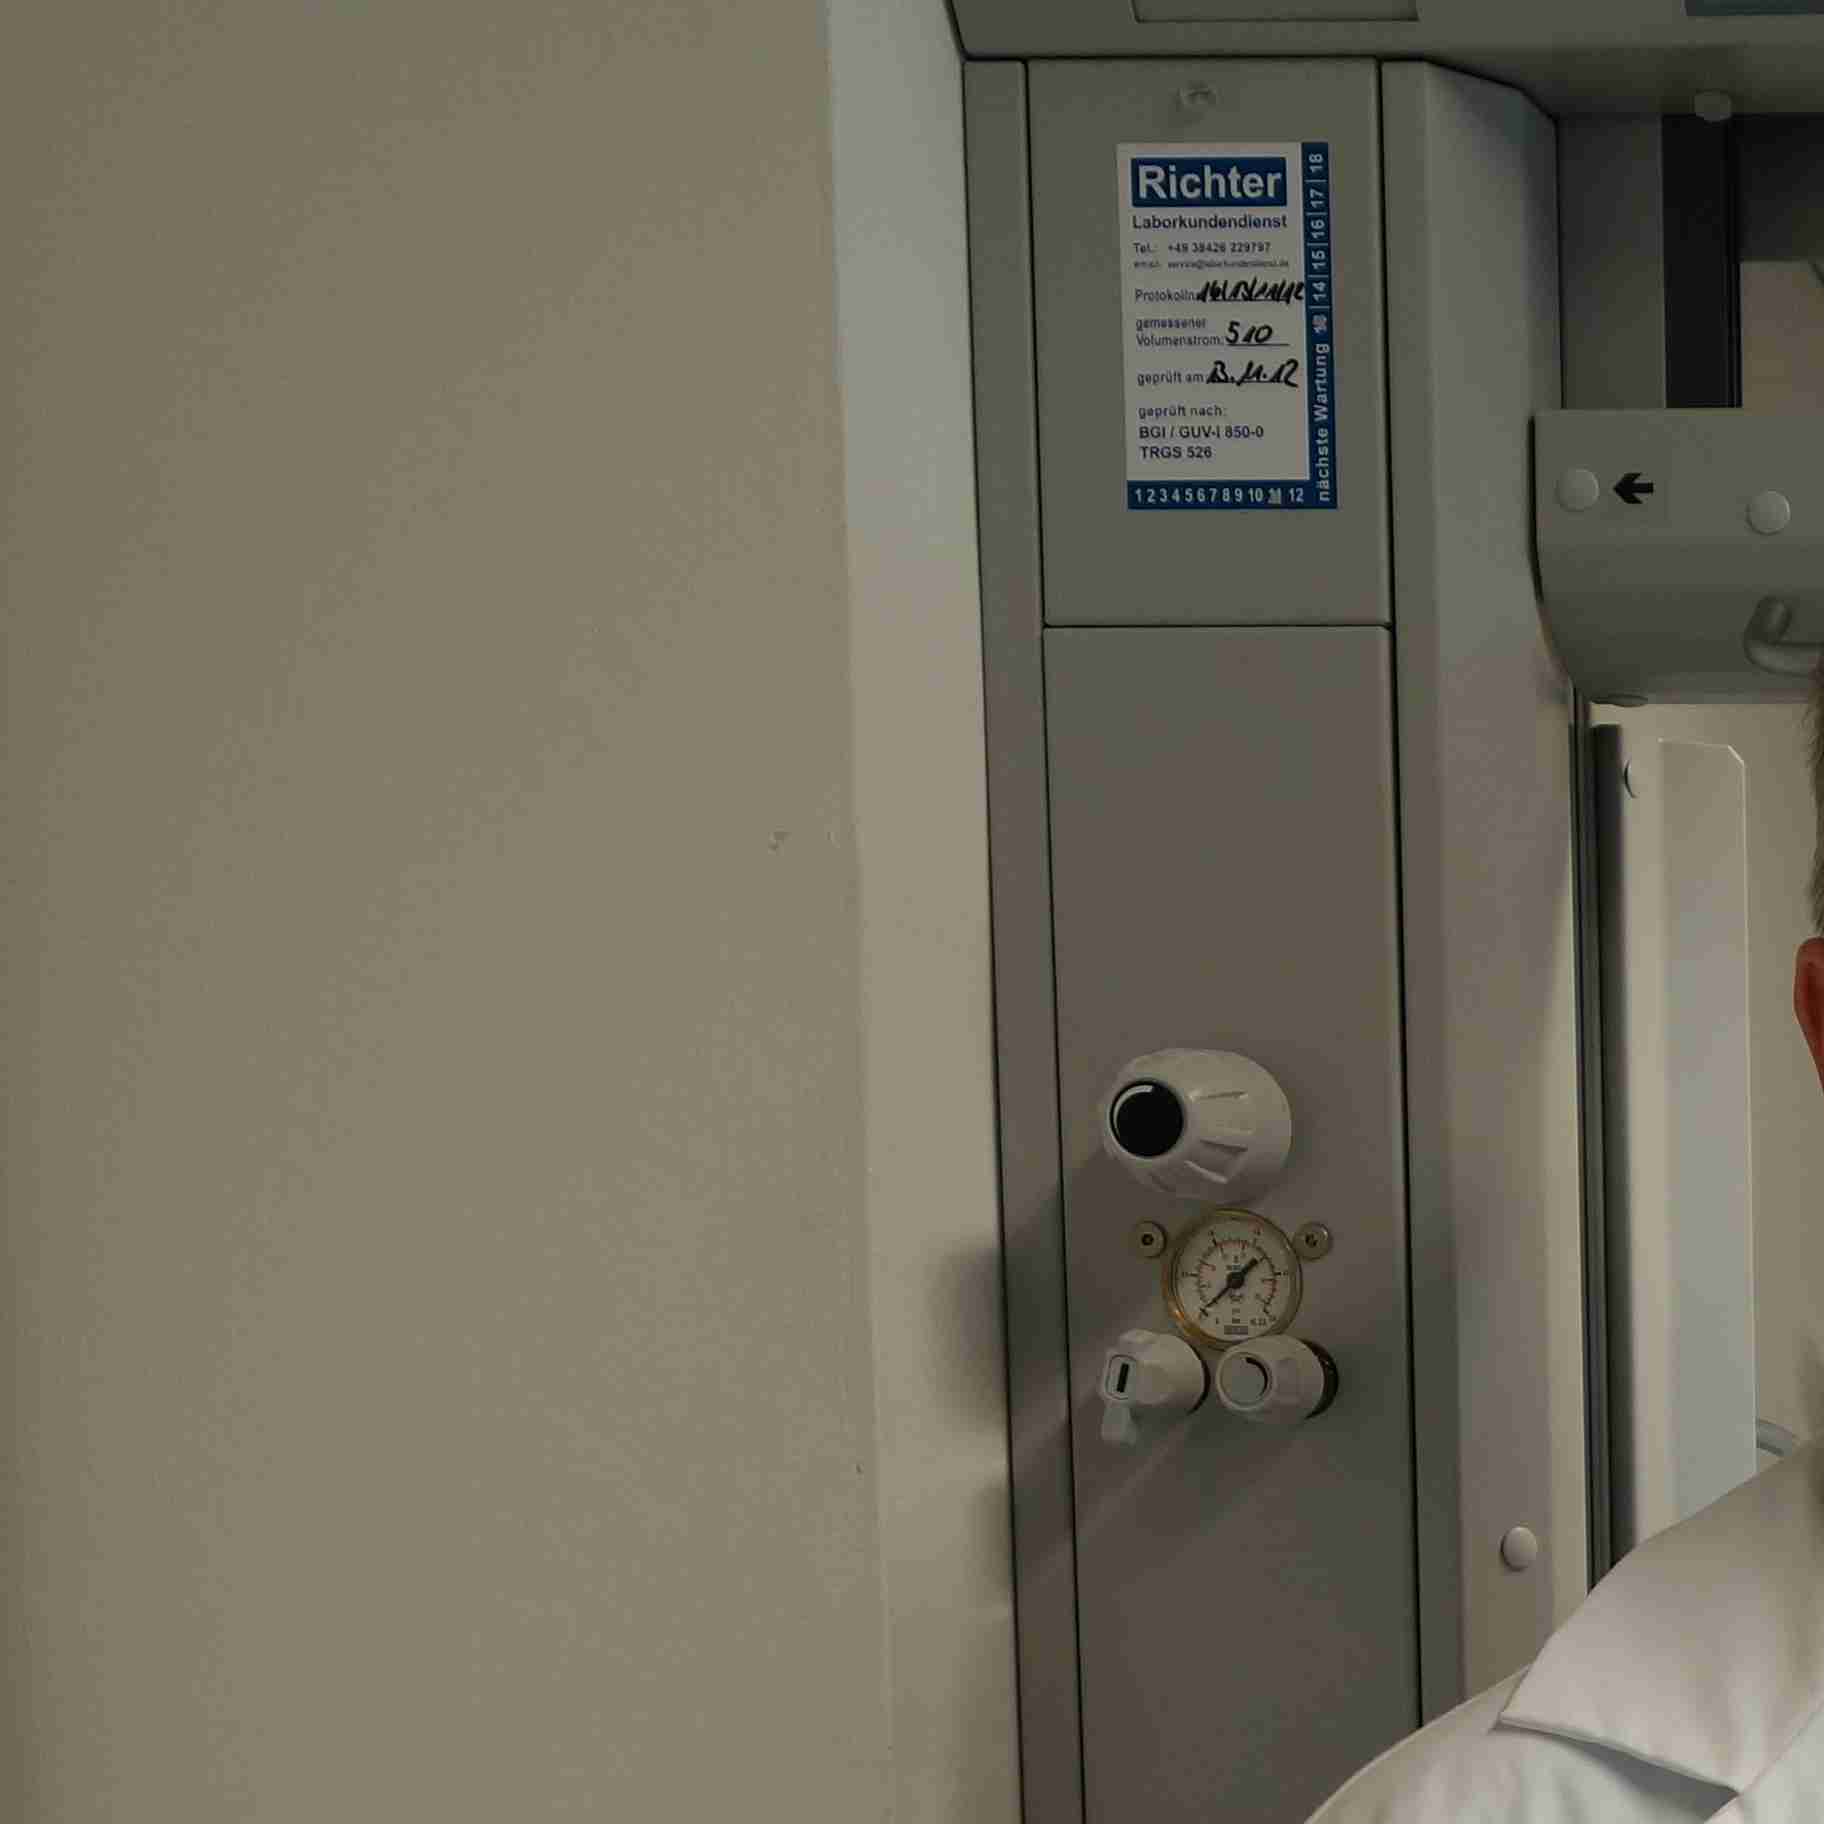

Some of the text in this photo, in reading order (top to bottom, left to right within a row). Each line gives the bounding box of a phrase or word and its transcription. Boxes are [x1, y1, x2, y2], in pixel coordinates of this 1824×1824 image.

[1309, 152, 1324, 173] 18
[1137, 163, 1283, 200] Richter
[1310, 188, 1324, 208] 17
[1132, 214, 1288, 230] Laborkundendienst
[1311, 219, 1325, 239] 16
[1312, 249, 1326, 270] 15
[1313, 280, 1327, 301] 14
[1311, 343, 1331, 422] Wartung
[1138, 426, 1167, 438] BGI
[1224, 426, 1264, 438] 850-0
[1139, 446, 1213, 458] TRGS 526
[1316, 428, 1330, 502] nächste
[1135, 488, 1142, 504] 1
[1147, 488, 1157, 504] 2
[1159, 488, 1168, 504] 3
[1171, 488, 1181, 504] 4
[1184, 488, 1193, 504] 5
[1196, 488, 1205, 504] 6
[1208, 488, 1218, 504] 7
[1221, 488, 1231, 504] 8
[1234, 488, 1243, 504] 9
[1248, 488, 1264, 504] 10
[1289, 488, 1304, 504] 12
